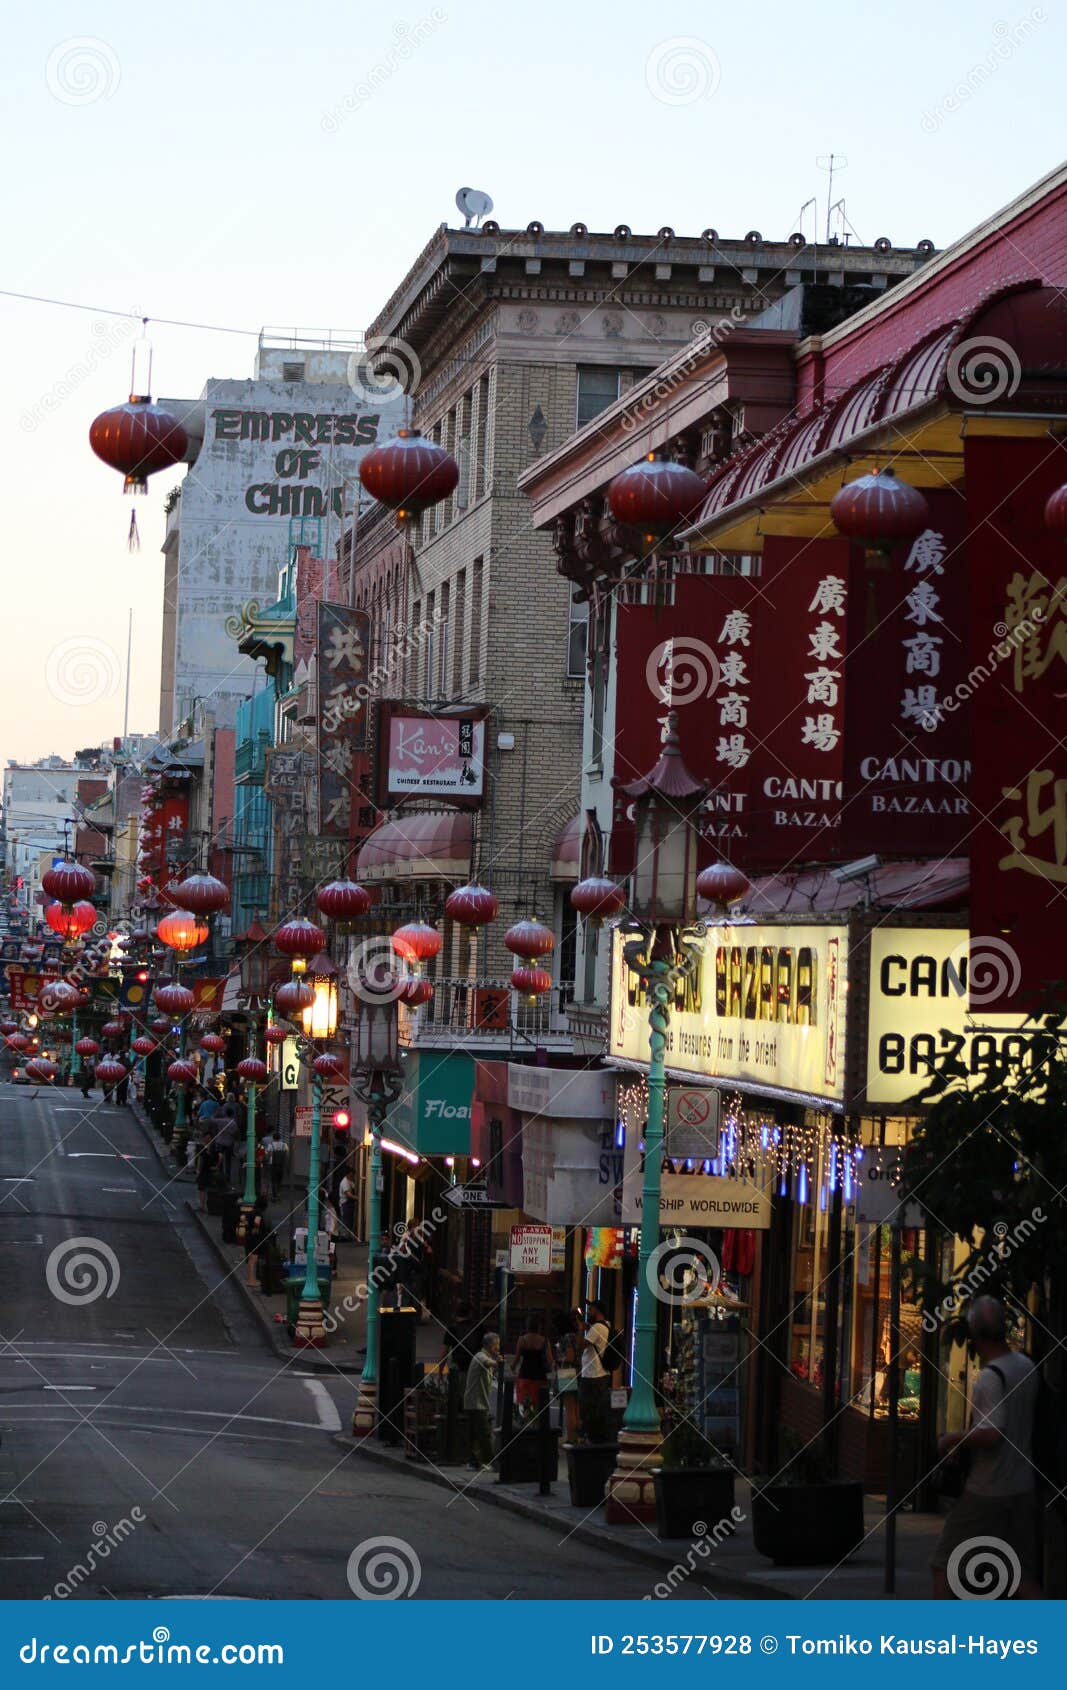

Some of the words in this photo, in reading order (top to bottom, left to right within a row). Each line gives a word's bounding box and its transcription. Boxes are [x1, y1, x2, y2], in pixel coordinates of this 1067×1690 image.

[212, 409, 380, 446] EMPRESS
[275, 449, 320, 479] OF
[900, 528, 948, 728] 廣東商場
[800, 575, 848, 752] 廣東商場
[715, 609, 752, 769] 廣東商場
[396, 721, 456, 764] Kan's
[872, 795, 970, 814] BAZAAR
[679, 1027, 712, 1058] treasures
[718, 1030, 733, 1061] from
[738, 1034, 750, 1063] the
[755, 1037, 777, 1067] orient
[879, 1032, 1050, 1078] BAZAA
[463, 1191, 484, 1201] ONE
[660, 1200, 685, 1211] SHIP
[691, 1201, 760, 1214] WORLDWIDE
[512, 1233, 522, 1245] NO
[523, 1247, 539, 1255] ANY
[521, 1256, 540, 1265] TIME
